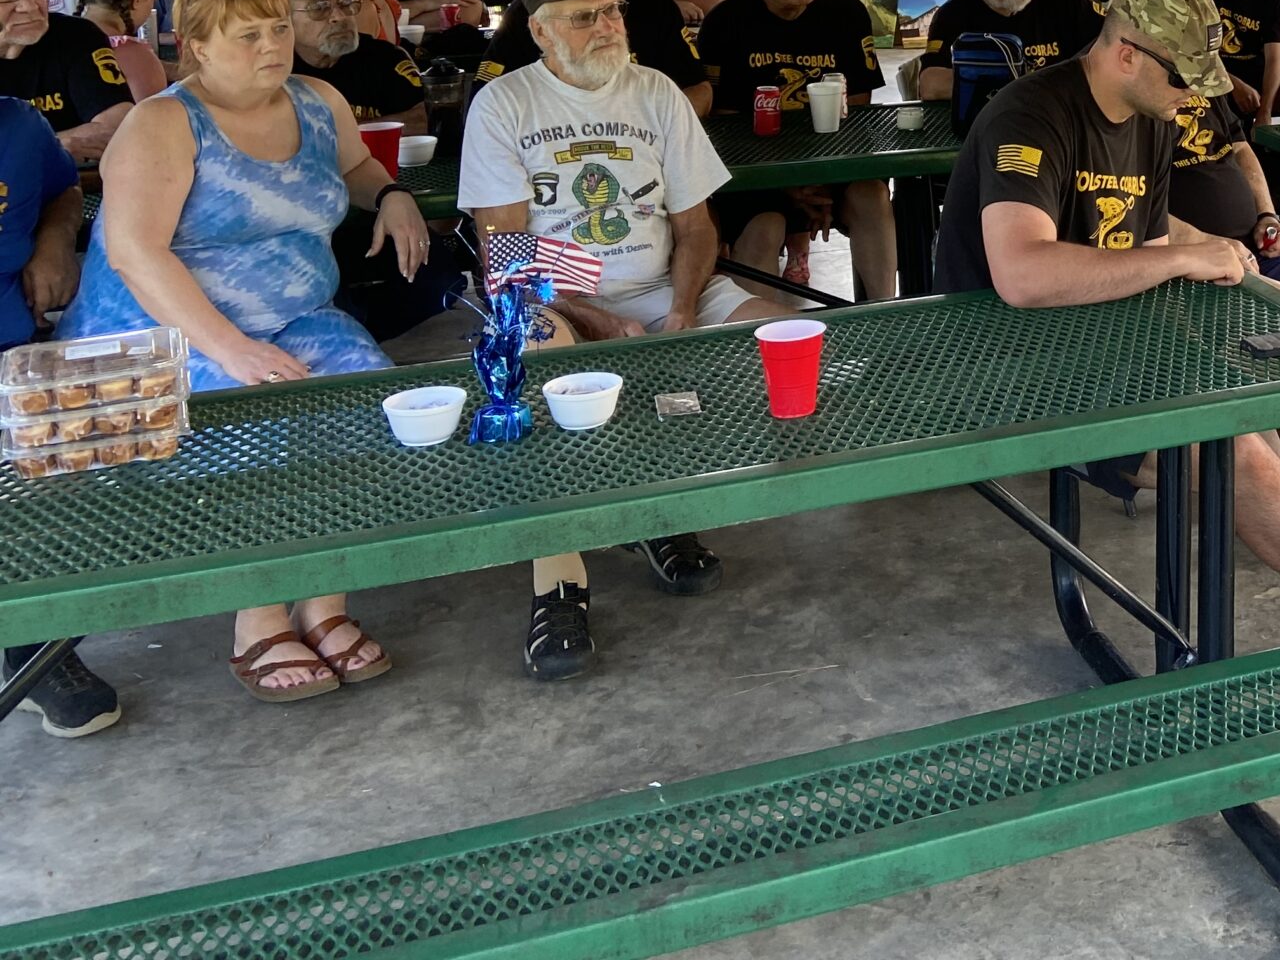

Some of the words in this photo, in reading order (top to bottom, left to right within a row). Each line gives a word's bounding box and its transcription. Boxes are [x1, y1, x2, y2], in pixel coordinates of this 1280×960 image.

[749, 53, 773, 68] COLD
[796, 54, 836, 68] COBRAS
[520, 123, 577, 150] COBRA
[581, 121, 659, 147] COMPANY
[1173, 159, 1191, 168] THIS
[1189, 157, 1199, 165] IS
[602, 246, 624, 257] with
